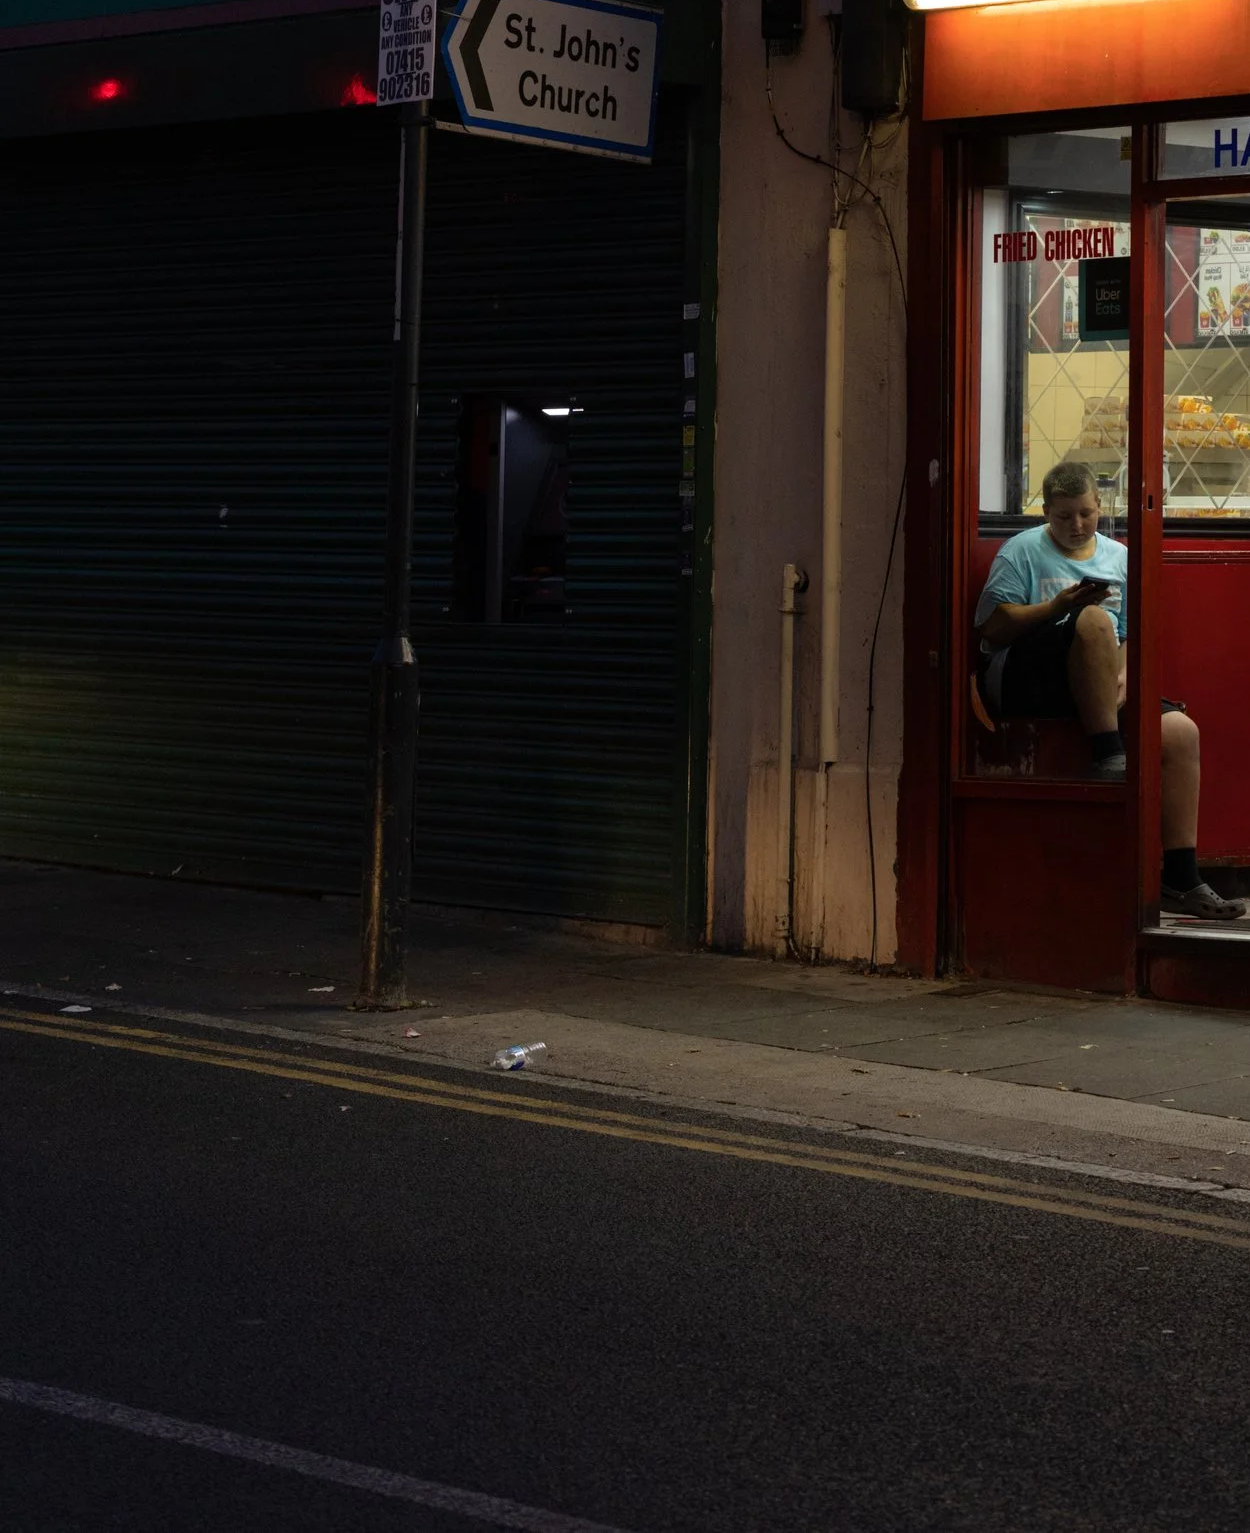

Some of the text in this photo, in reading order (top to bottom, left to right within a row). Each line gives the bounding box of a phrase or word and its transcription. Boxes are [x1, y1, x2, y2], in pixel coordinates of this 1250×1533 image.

[400, 1, 414, 17] ANY
[393, 16, 420, 33] VEHICLE
[381, 29, 432, 50] ANY CONDITION
[504, 13, 640, 72] St. John's
[386, 47, 425, 75] 07415
[379, 71, 431, 102] 902316
[518, 70, 617, 121] Church
[993, 227, 1114, 263] FRIED CHICKEN
[1095, 288, 1121, 301] Uber
[1095, 302, 1121, 315] Eats
